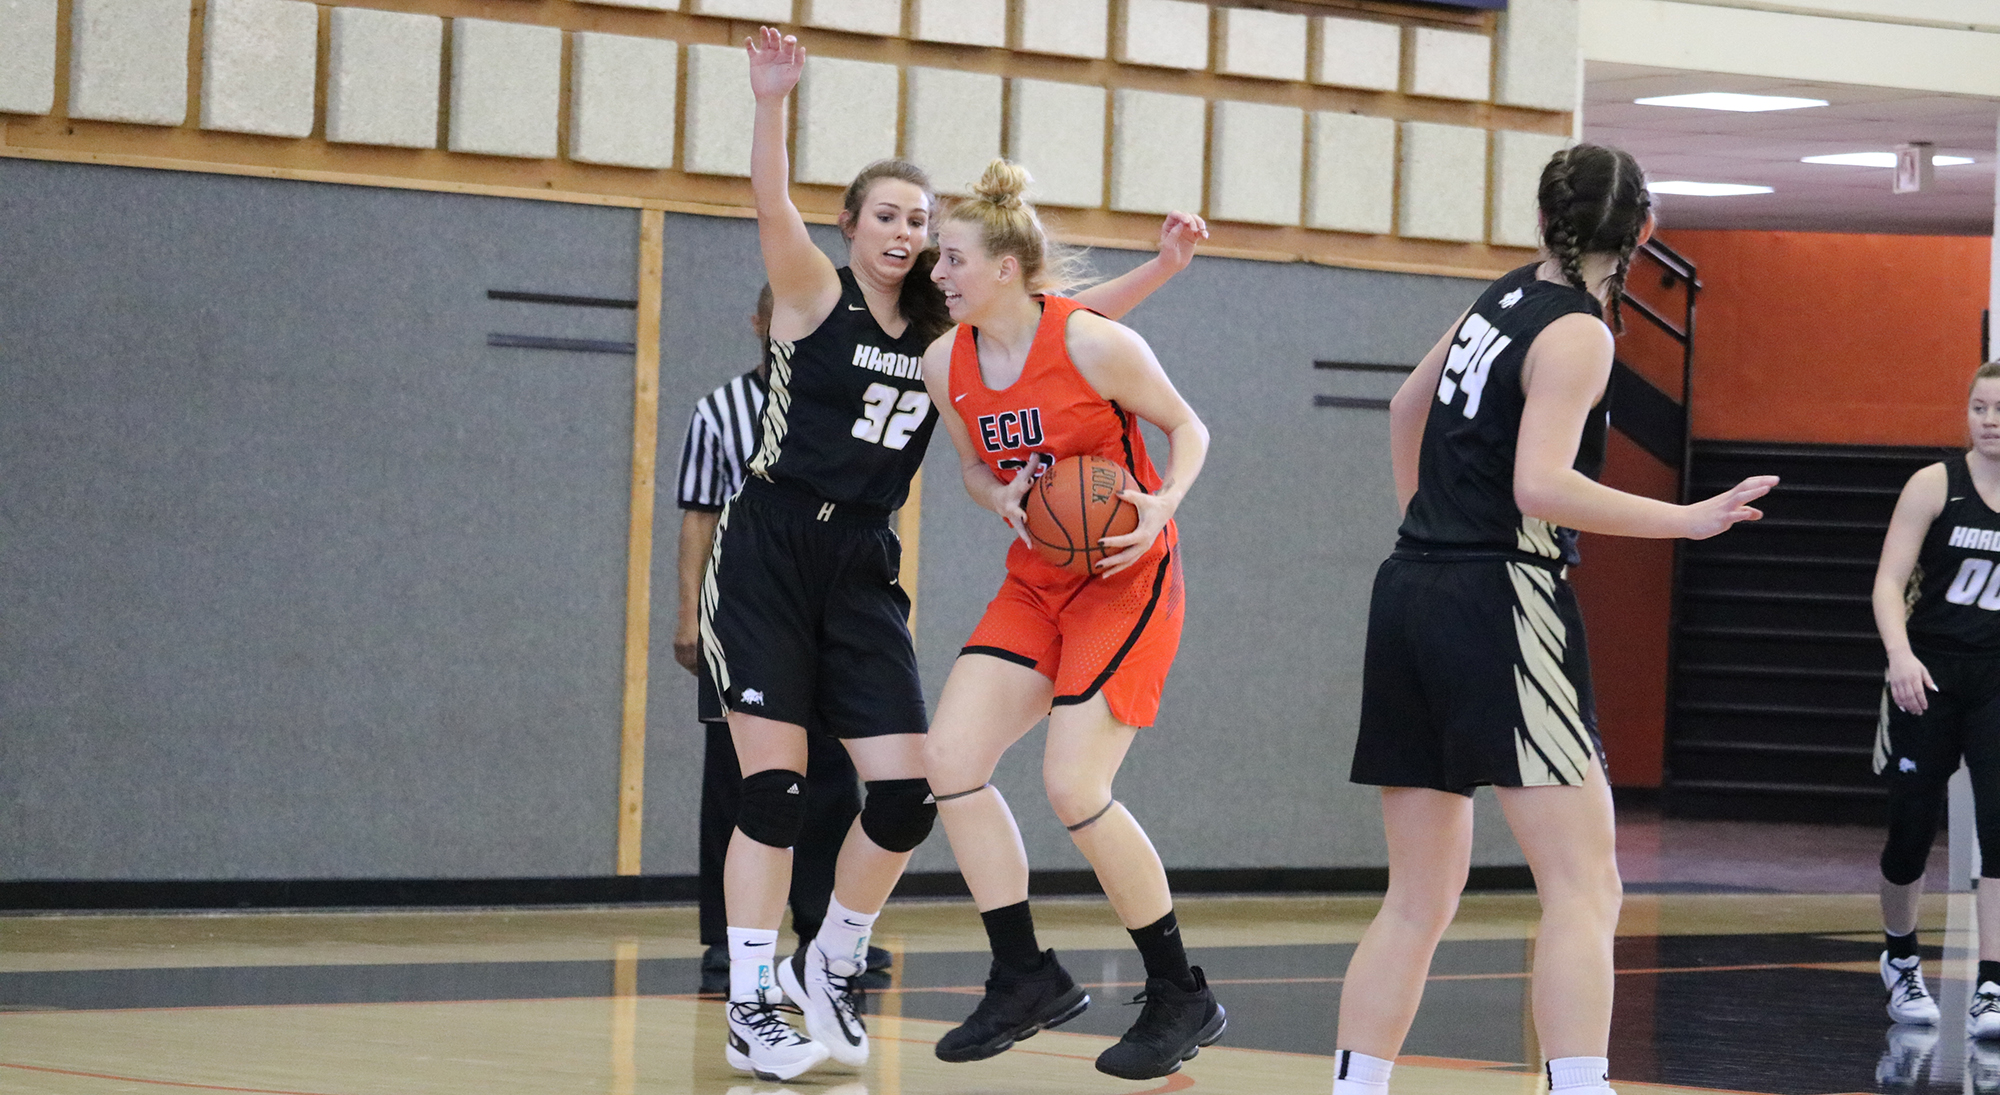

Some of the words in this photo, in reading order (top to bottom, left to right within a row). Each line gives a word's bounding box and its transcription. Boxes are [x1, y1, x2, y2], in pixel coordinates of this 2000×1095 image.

[1437, 312, 1512, 420] 24
[851, 382, 931, 451] 32
[977, 407, 1045, 453] ECU
[1091, 466, 1117, 505] ROCK
[816, 501, 836, 522] H
